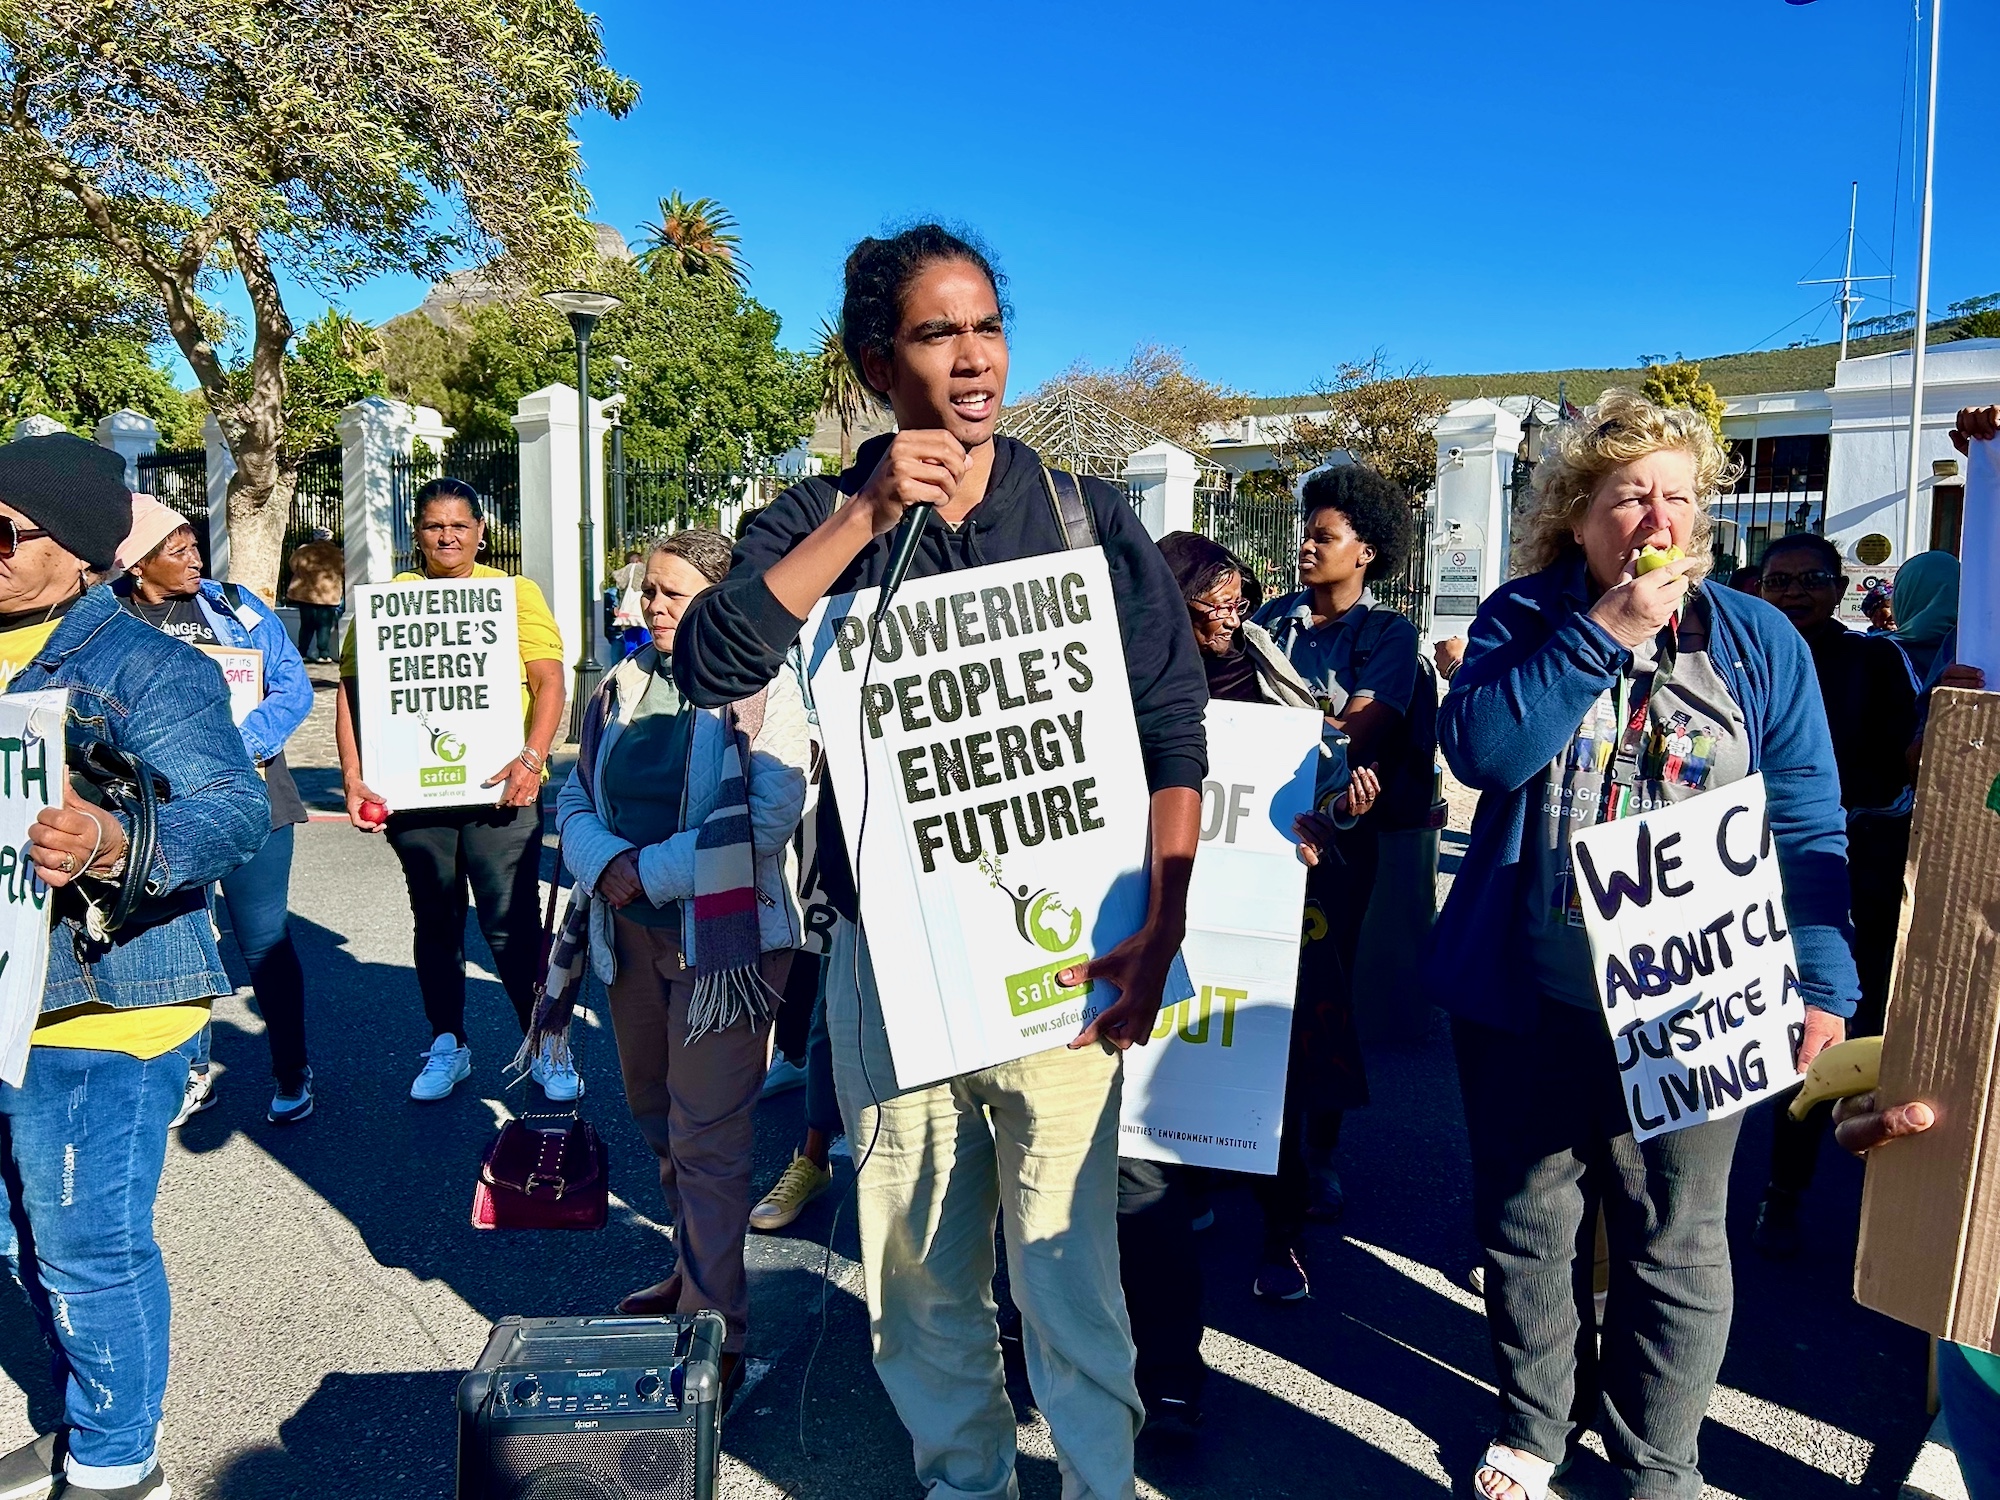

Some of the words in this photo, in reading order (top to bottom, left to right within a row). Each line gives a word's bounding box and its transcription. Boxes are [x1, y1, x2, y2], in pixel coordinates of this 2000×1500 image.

[370, 588, 502, 619] POWERING
[163, 622, 213, 641] ANGELS
[377, 620, 498, 651] PEOPLE'S
[832, 572, 1092, 673] POWERING
[224, 669, 255, 684] SAFE
[225, 658, 235, 668] IF
[389, 652, 488, 682] ENERGY
[390, 684, 490, 715] FUTURE
[860, 641, 1094, 739] PEOPLE'S
[897, 710, 1086, 804] ENERGY
[423, 768, 462, 784] safcei
[1545, 781, 1575, 798] The
[913, 776, 1106, 873] FUTURE
[1541, 801, 1588, 822] egacy
[1575, 820, 1695, 921] WE
[1606, 909, 1735, 1010] ABOUT
[1020, 1005, 1099, 1039] www.safcei.org
[1618, 977, 1766, 1072] JUSTICE
[1632, 1039, 1769, 1132] LIVING
[1158, 1129, 1213, 1145] ENVIRONMENT
[1215, 1136, 1258, 1150] INSTITUTE
